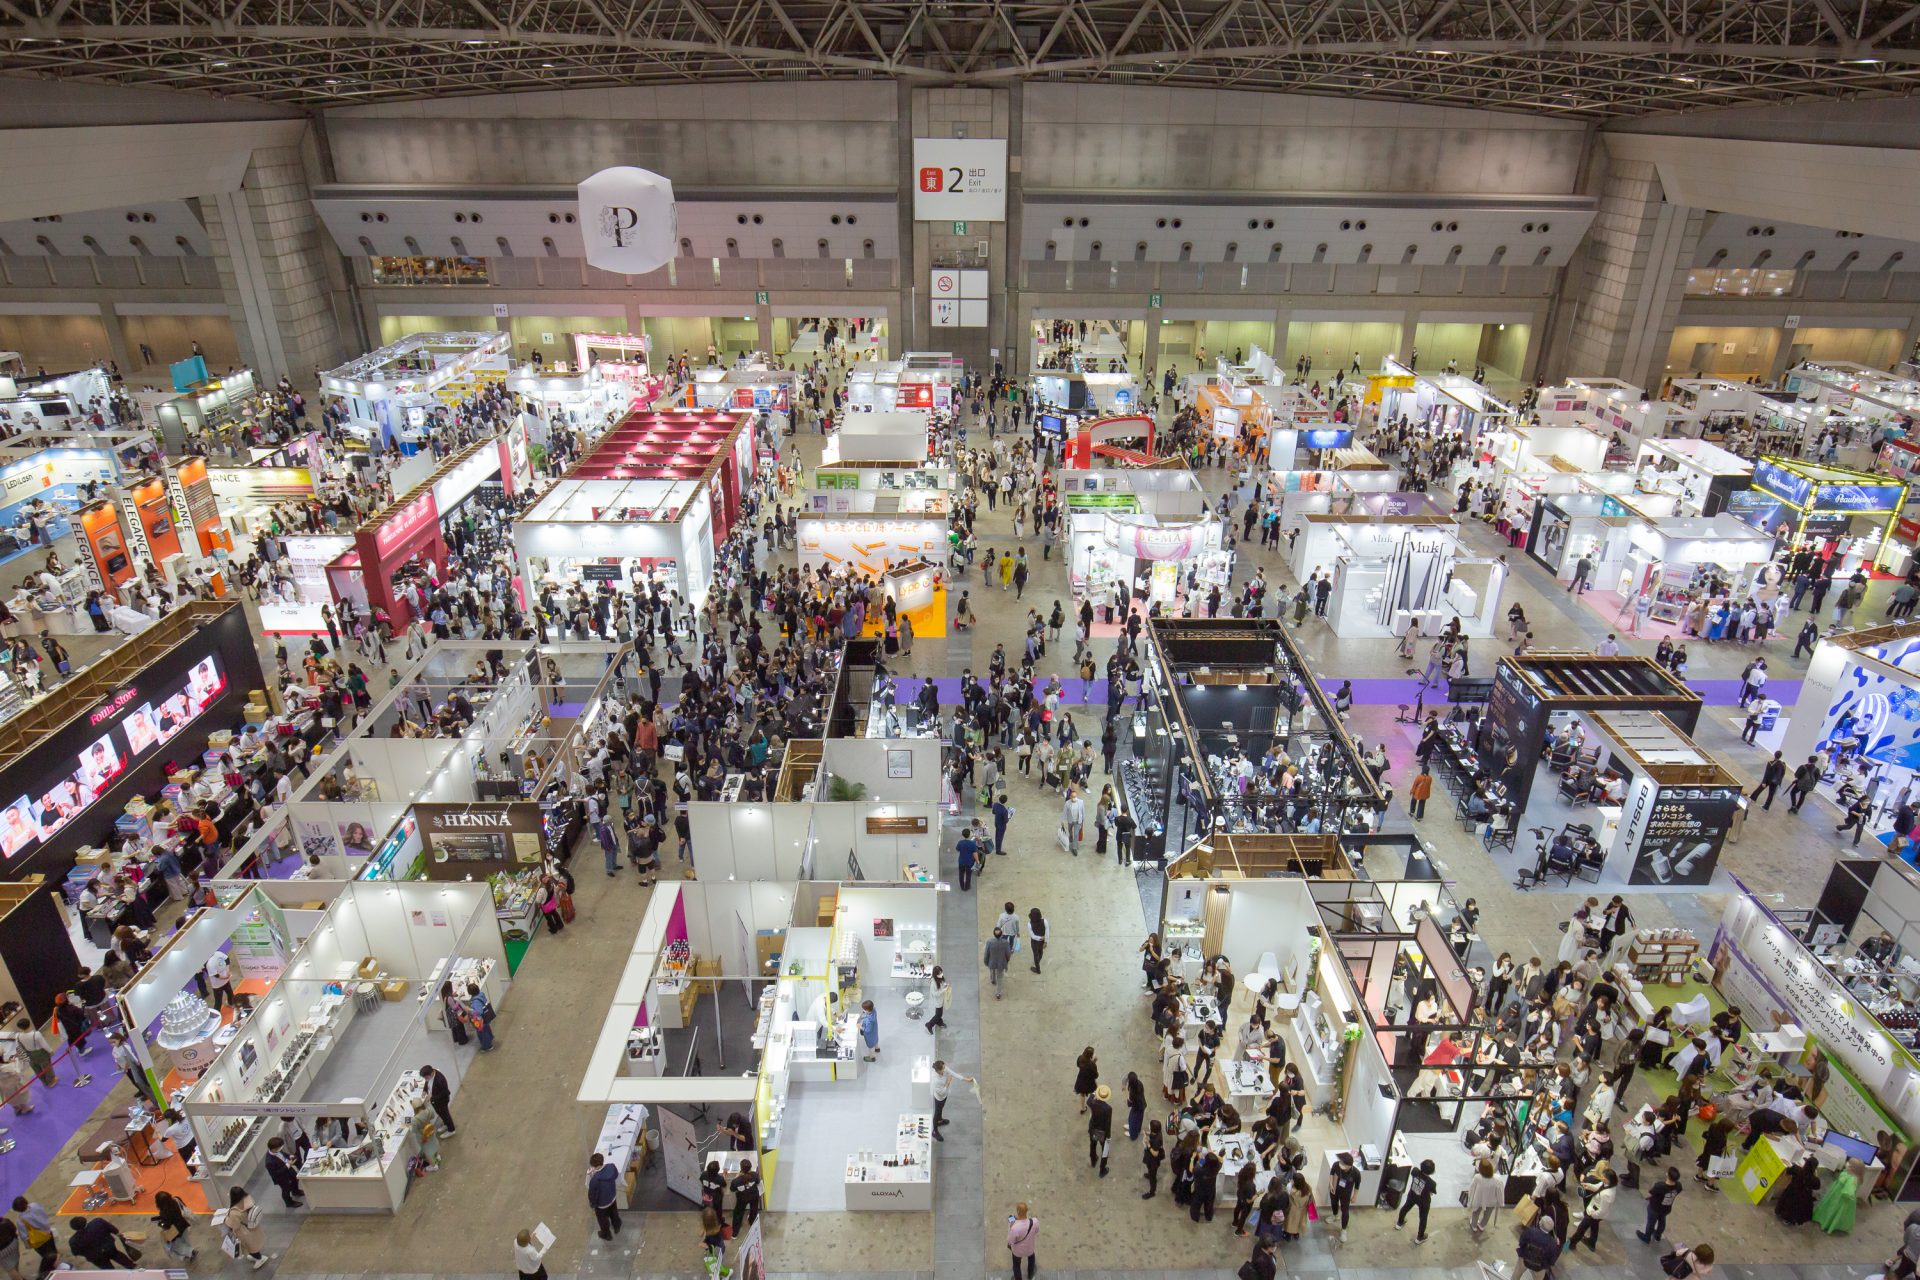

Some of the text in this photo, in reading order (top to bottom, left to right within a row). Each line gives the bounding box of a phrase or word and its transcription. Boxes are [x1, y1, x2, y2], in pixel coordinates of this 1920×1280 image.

[926, 177, 937, 190] 東
[948, 167, 964, 193] 2
[968, 168, 986, 177] 出口
[968, 179, 982, 187] Exit
[606, 205, 638, 248] P
[169, 474, 194, 533] ELEGANCE
[122, 497, 150, 557] ELEGANCE
[71, 522, 101, 585] ELEGANCE
[90, 704, 116, 727] Foula
[114, 687, 138, 709] Store
[1658, 789, 1733, 800] BOSLEY
[442, 814, 513, 827] HENNA
[1624, 784, 1649, 853] BOSLEY
